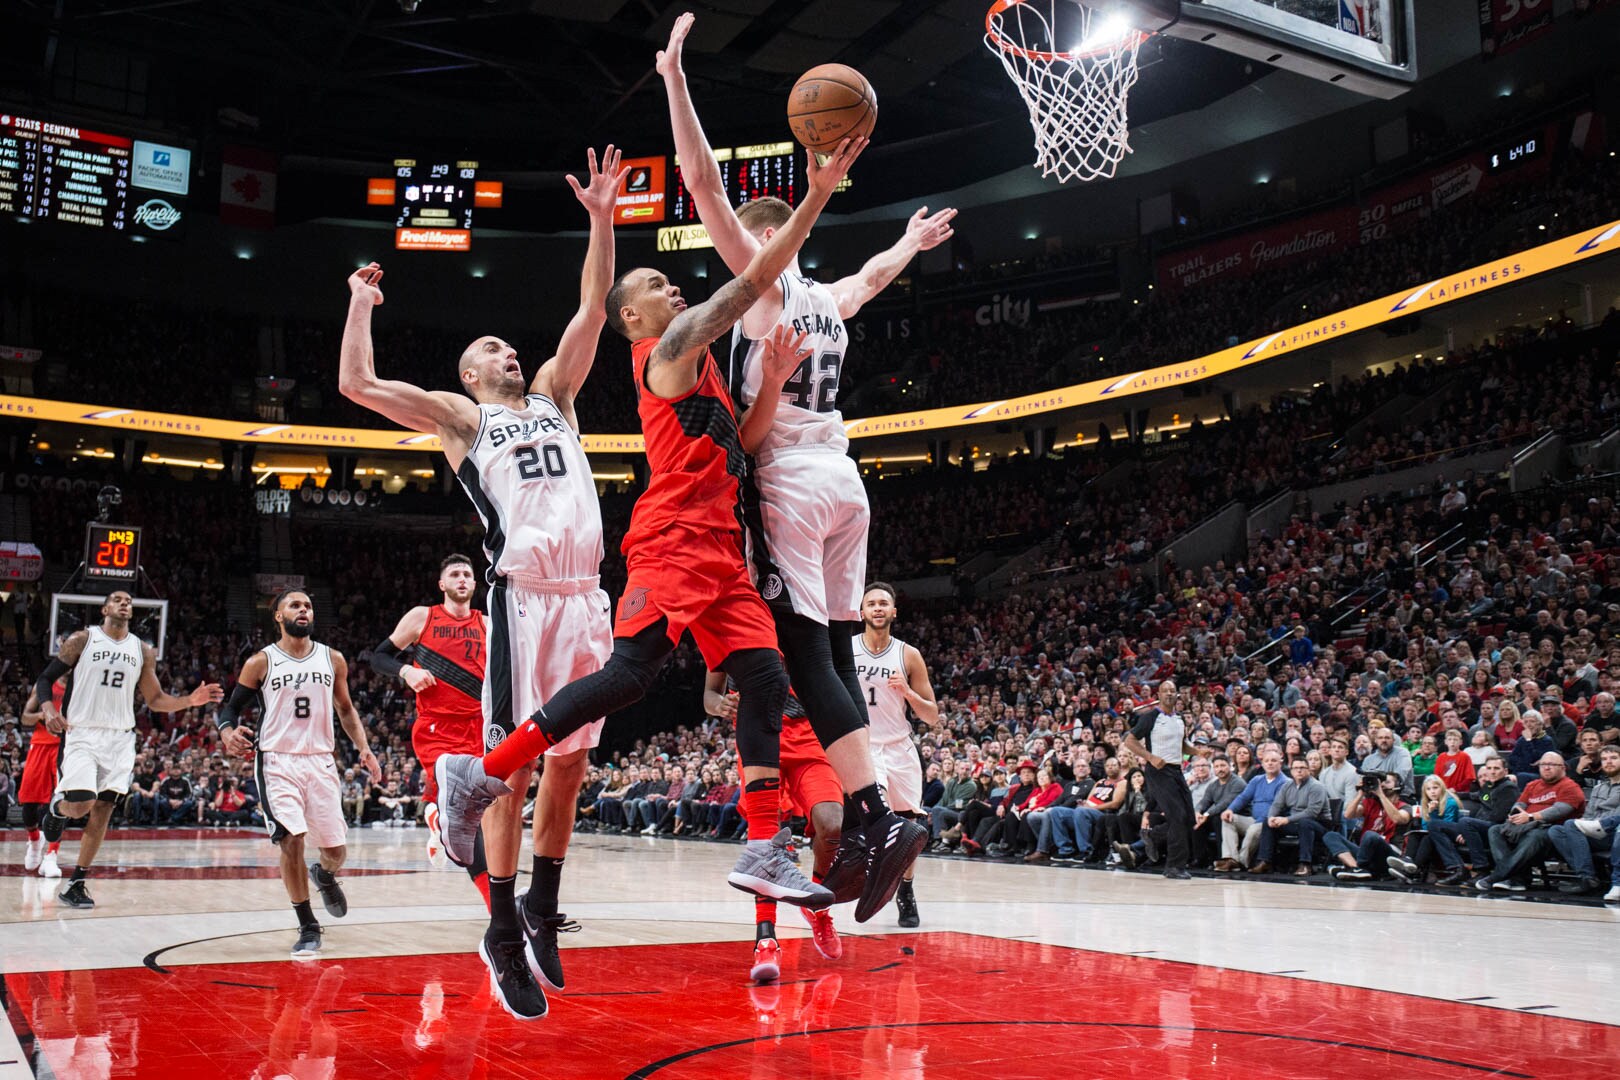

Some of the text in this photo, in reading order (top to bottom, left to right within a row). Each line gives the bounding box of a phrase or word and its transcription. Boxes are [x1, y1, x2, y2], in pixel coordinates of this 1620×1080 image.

[1343, 17, 1357, 32] NBA
[15, 118, 80, 138] STATS CENTRAL
[59, 149, 83, 159] POINTS
[93, 154, 111, 164] PAINT
[71, 161, 91, 171] BREAK
[92, 164, 114, 175] POINTS
[138, 165, 183, 177] PACIFIC OFFICE
[397, 167, 412, 177] 105
[460, 169, 475, 178] 108
[71, 172, 97, 183] ASSISTS
[140, 172, 182, 182] AUTOMATION
[65, 181, 103, 195] TURNOVERS
[57, 191, 87, 203] CHARGES
[88, 196, 108, 206] TAKEN
[616, 193, 664, 205] OWNLOAD APP
[61, 202, 80, 212] TOTAL
[82, 205, 102, 215] FOULS
[402, 206, 410, 217] 5
[464, 209, 472, 217] 4
[1359, 204, 1386, 226] 50
[58, 212, 80, 223] BENCH
[81, 216, 104, 227] POINTS
[396, 217, 404, 227] 2
[464, 219, 472, 228] 2
[1360, 223, 1386, 244] 50
[1250, 229, 1336, 268] Foundation
[1169, 256, 1204, 278] TRAIL
[1183, 252, 1242, 287] BLAZERS
[1429, 264, 1521, 300] LA FITNESS
[975, 294, 1031, 328] city
[1273, 320, 1347, 350] LA FITNESS
[781, 350, 842, 413] 42
[1134, 366, 1207, 388] LA FITNESS
[0, 403, 34, 413] NESS
[997, 396, 1063, 416] LA FITNESS
[144, 419, 201, 432] FITNESS
[490, 417, 565, 447] SPURS
[875, 418, 925, 431] FITNESS
[301, 434, 356, 443] FITNESS
[514, 445, 567, 480] 20
[256, 489, 291, 501] BLOCK
[108, 530, 134, 545] 1:43
[97, 542, 129, 567] 20
[102, 568, 135, 577] TISSOT
[433, 626, 480, 640] PORTLAND
[465, 640, 481, 660] 27
[92, 650, 136, 667] SPURS
[100, 669, 125, 688] 12
[857, 665, 896, 681] PUR
[271, 672, 332, 691] SPURS
[869, 687, 877, 706] 1
[295, 696, 310, 718] 8
